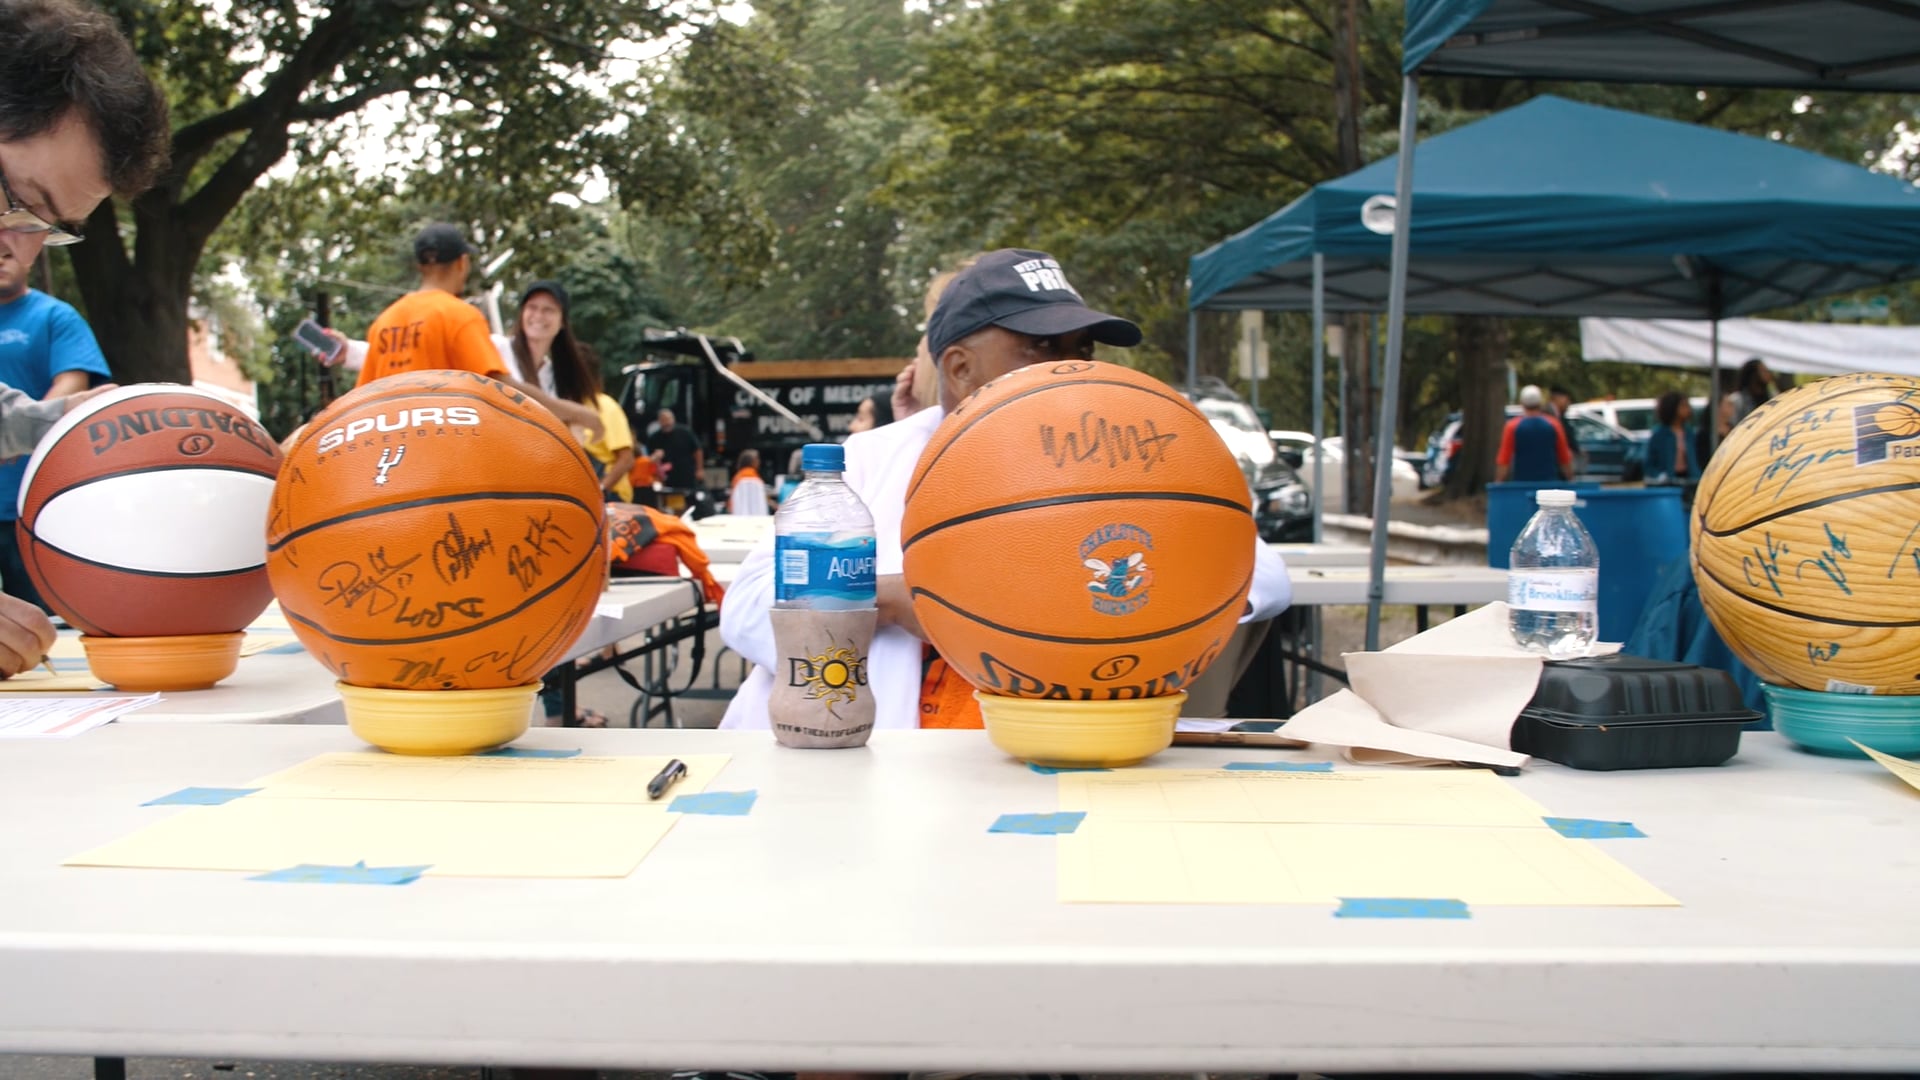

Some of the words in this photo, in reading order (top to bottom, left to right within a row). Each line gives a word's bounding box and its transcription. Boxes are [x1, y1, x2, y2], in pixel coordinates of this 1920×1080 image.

[789, 387, 815, 405] OF
[823, 384, 897, 404] MEDF
[317, 406, 481, 454] SPURS
[758, 414, 819, 433] PUBC
[317, 428, 482, 465] BASKETBALL
[978, 640, 1220, 700] SPALDING
